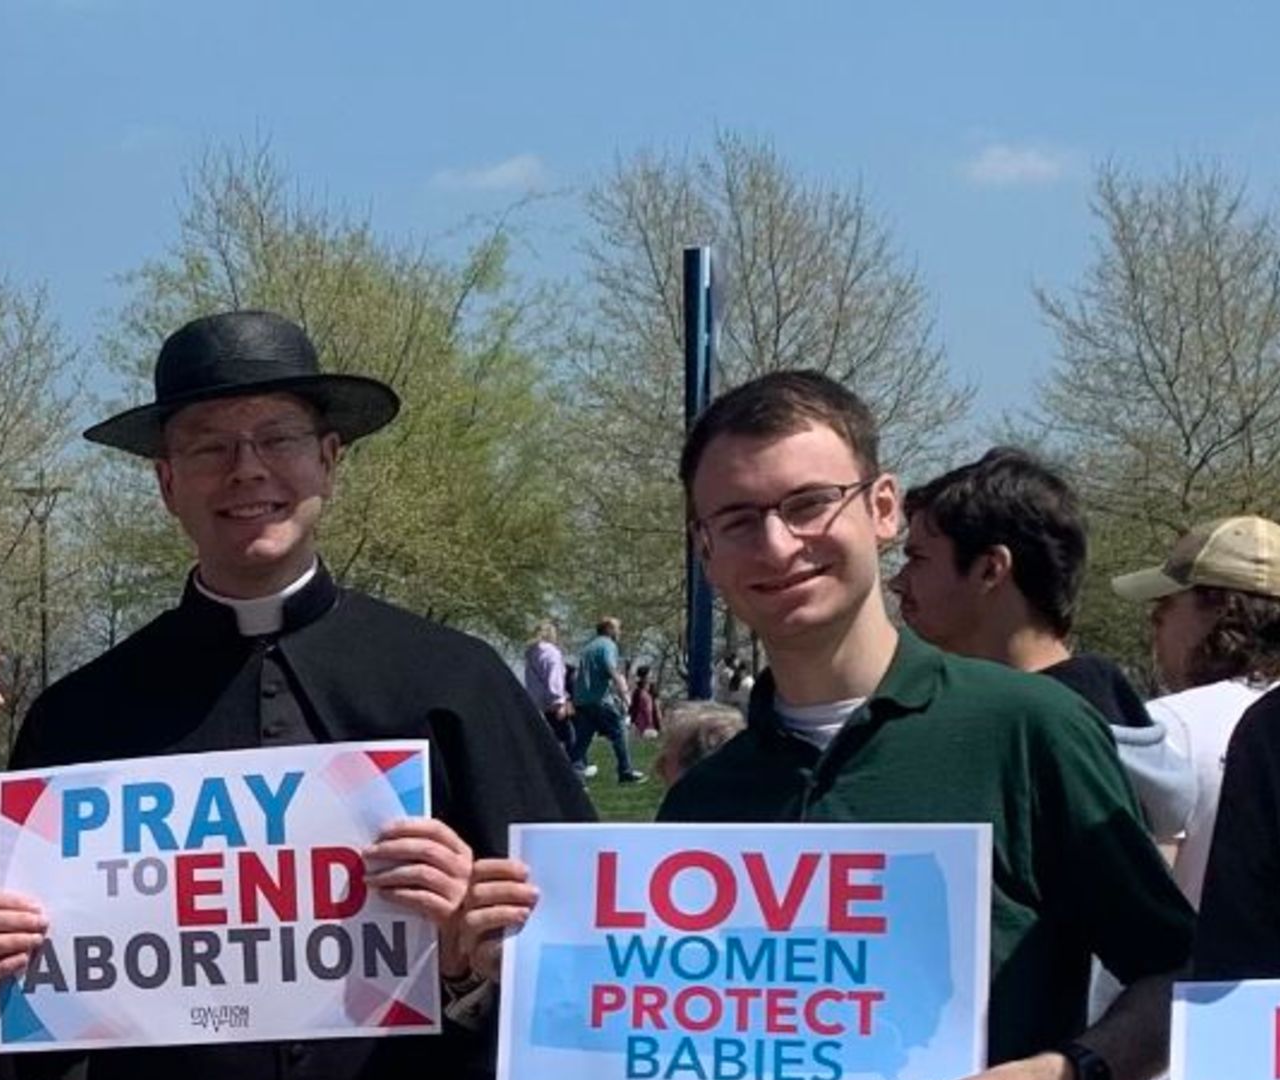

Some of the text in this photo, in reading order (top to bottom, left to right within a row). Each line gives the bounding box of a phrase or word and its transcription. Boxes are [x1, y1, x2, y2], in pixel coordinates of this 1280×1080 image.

[61, 771, 304, 858] PRAY
[97, 846, 369, 927] TO END
[594, 850, 887, 934] LOVE
[22, 921, 409, 994] ABORTION
[605, 934, 867, 984] WOMEN
[589, 984, 885, 1035] PROTECT
